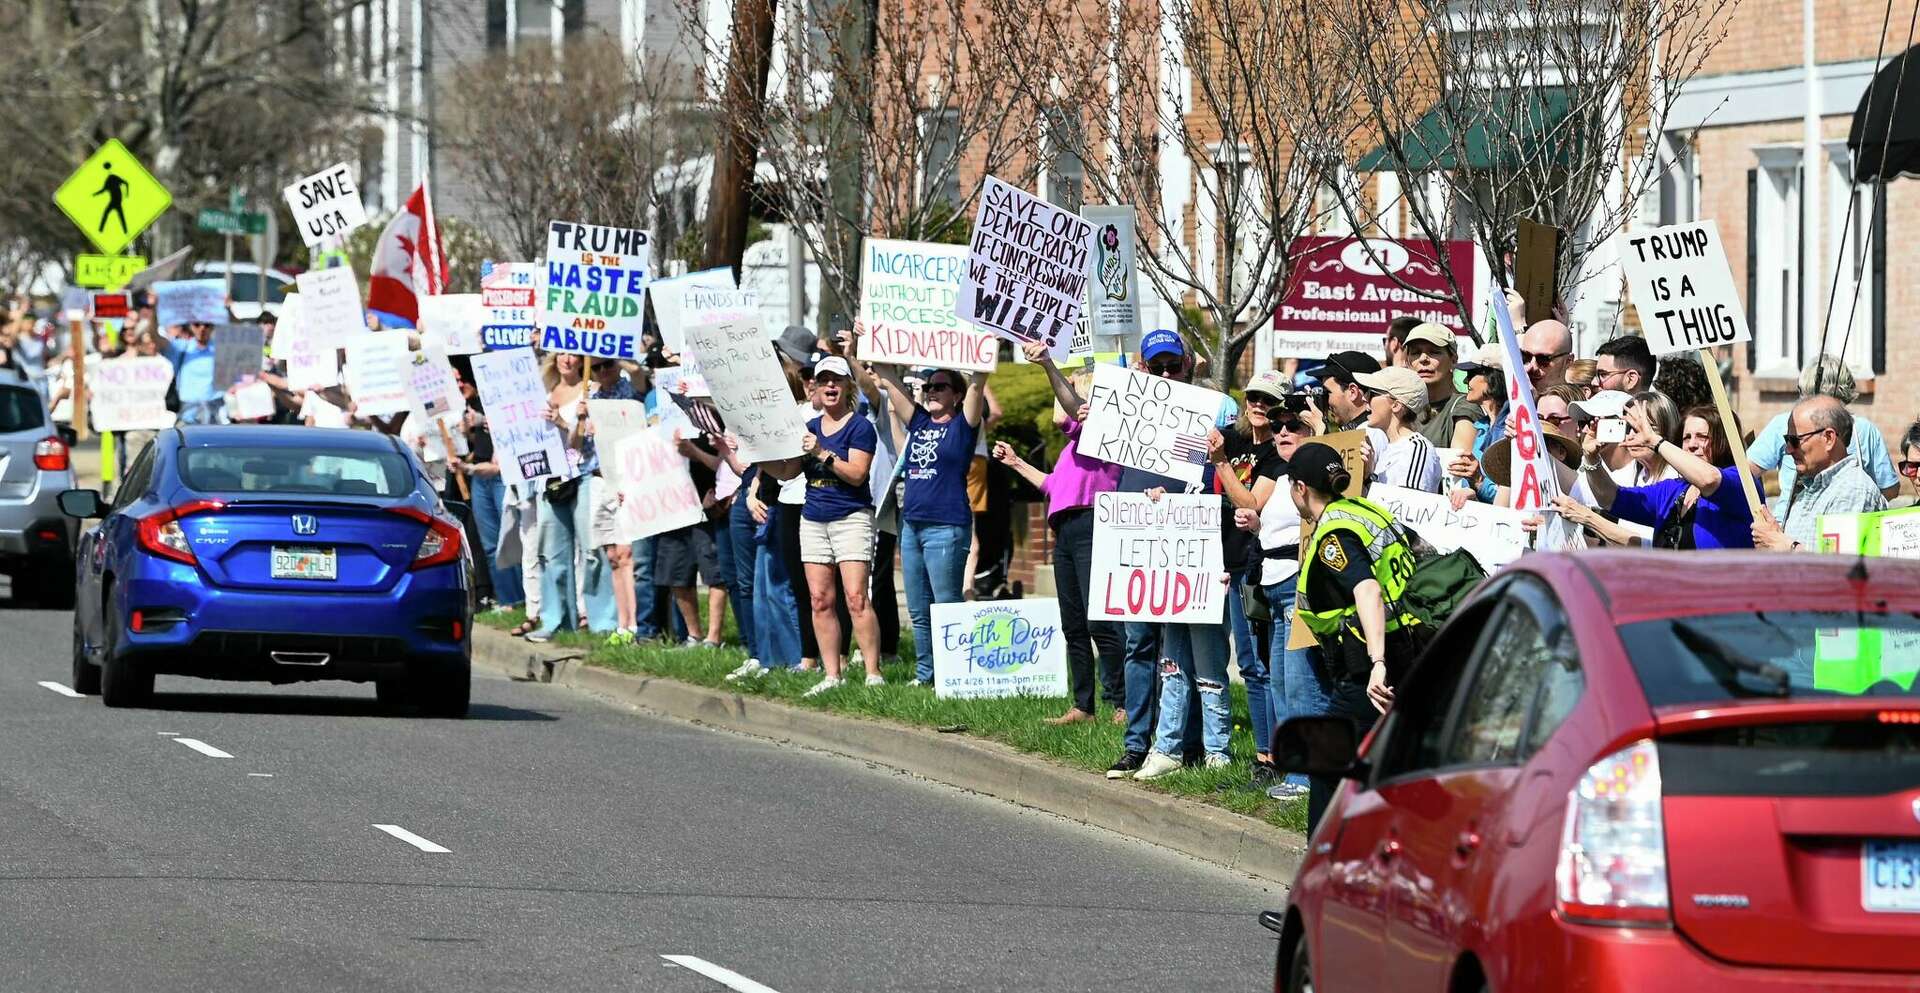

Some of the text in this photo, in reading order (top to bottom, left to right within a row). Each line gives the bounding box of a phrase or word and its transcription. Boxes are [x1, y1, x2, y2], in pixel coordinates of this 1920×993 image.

[299, 169, 352, 208] SAVE
[308, 210, 347, 236] USA
[986, 184, 1091, 249] SAVE OUR
[552, 223, 647, 256] TRUMP
[981, 205, 1087, 273] DEMOCRACY!
[1630, 228, 1708, 262] TRUMP
[582, 253, 620, 266] IS THE
[872, 246, 966, 284] INCARCERA
[990, 240, 1060, 289] CONGRESS
[1361, 248, 1390, 266] 71
[549, 261, 643, 294] WASTE
[970, 259, 990, 285] WE
[996, 272, 1020, 299] THE
[1023, 286, 1077, 325] PEOPLE
[1302, 281, 1355, 300] East
[1651, 274, 1695, 301] IS A
[547, 287, 639, 317] FRAUD
[685, 292, 733, 309] HANDS
[870, 284, 936, 304] WITHOUT
[492, 310, 525, 320] TO BE
[573, 318, 605, 330] AND
[869, 302, 957, 327] PROCESS
[974, 288, 1065, 347] WILL!
[1281, 306, 1387, 323] Professional
[1655, 303, 1736, 346] THUG
[543, 326, 634, 358] ABUSE
[872, 324, 993, 363] KIDNAPPING
[1279, 340, 1384, 354] Property Manageme
[1127, 372, 1171, 401] NO
[1089, 385, 1213, 437] FASCISTS
[1118, 418, 1157, 446] NO
[1098, 433, 1172, 473] KINGS
[1099, 494, 1221, 530] Silence is Acceptanc
[1381, 497, 1439, 527] TALIN
[1445, 510, 1479, 529] DID
[1120, 536, 1209, 568] LET'S GET
[1105, 569, 1210, 616] LOUD!!!
[973, 606, 1021, 621] NORWALK
[941, 617, 1056, 651] Earth Day
[964, 640, 1039, 673] Festival
[945, 678, 961, 688] SAT
[1033, 673, 1057, 683] FREE
